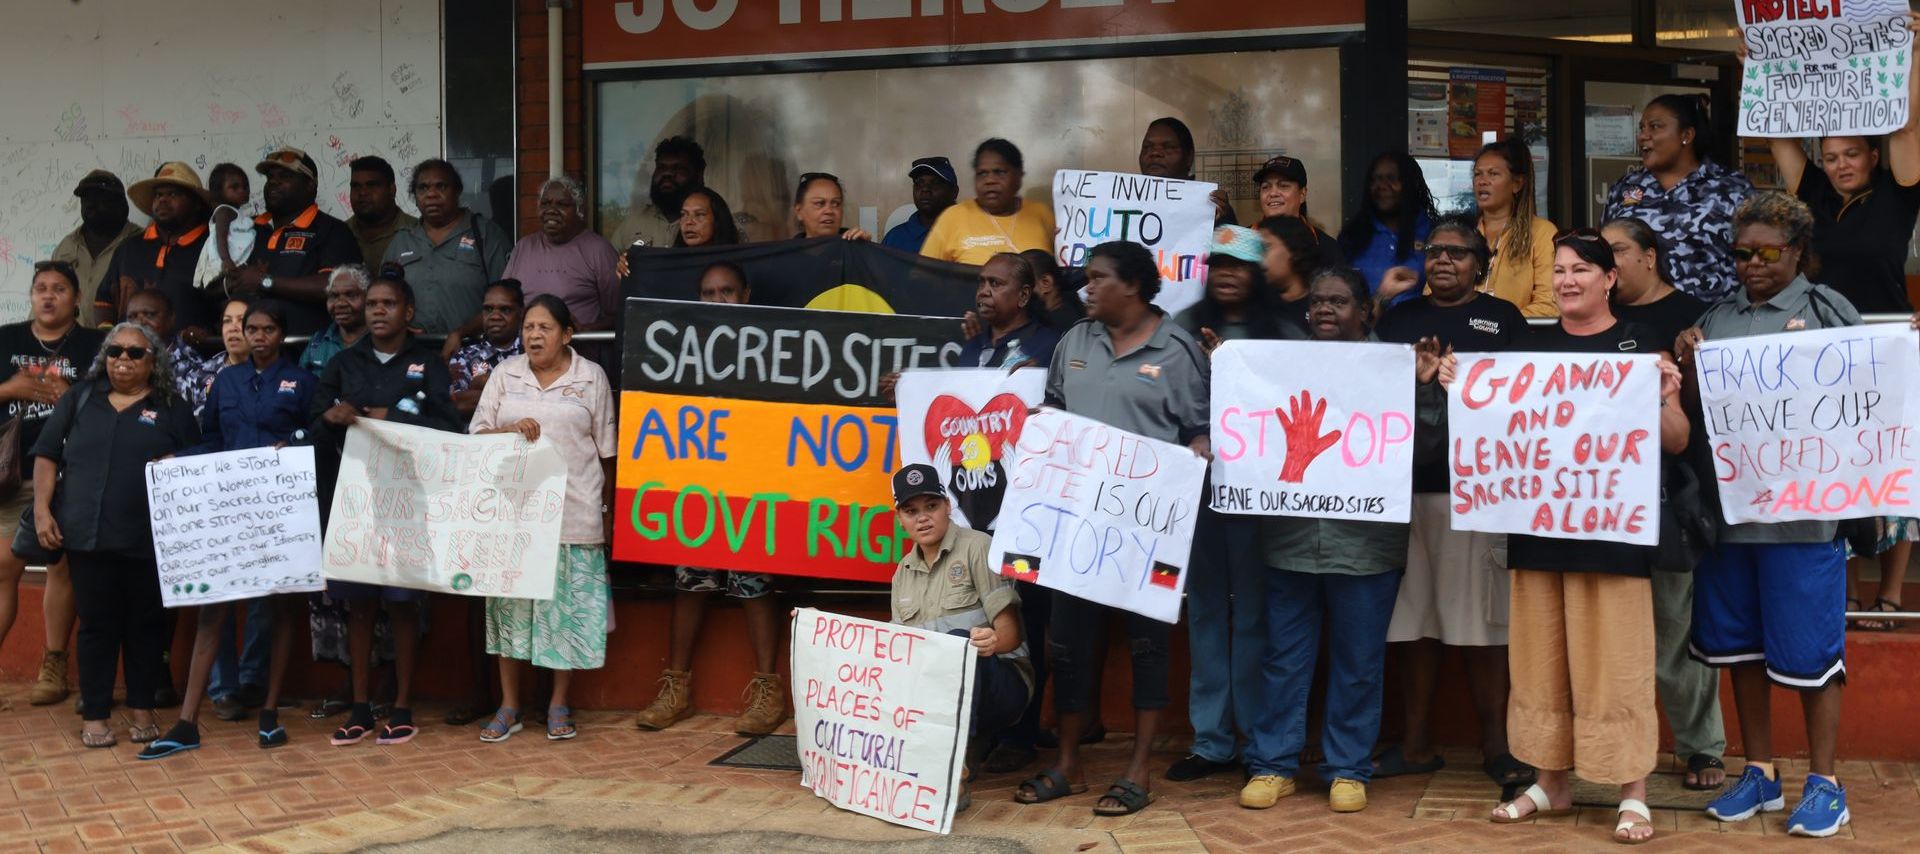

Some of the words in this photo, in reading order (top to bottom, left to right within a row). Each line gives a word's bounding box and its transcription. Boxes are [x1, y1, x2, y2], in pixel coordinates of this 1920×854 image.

[1745, 25, 1828, 61] SACRED
[1766, 68, 1873, 101] FUTURE
[1804, 64, 1819, 73] FOR
[1821, 62, 1838, 71] THE
[1746, 97, 1907, 136] GENERATION
[1061, 173, 1098, 199] WE
[1112, 175, 1185, 202] INVITE
[1157, 248, 1209, 287] WITH
[640, 320, 832, 391] SACRED
[1700, 344, 1799, 394] FRACK
[1813, 337, 1888, 387] OFF
[940, 406, 1014, 438] COUNTRY
[1507, 400, 1575, 437] AND
[1708, 398, 1798, 435] LEAVE
[1811, 390, 1884, 431] OUR
[632, 405, 730, 461] ARE
[787, 414, 898, 473] NOT
[1018, 411, 1159, 480] SACRED
[1454, 436, 1551, 477] LEAVE
[1574, 429, 1649, 465] OUR
[1715, 436, 1840, 482] SACRED
[1850, 424, 1915, 467] SITE
[366, 438, 536, 486] PROTECT
[956, 462, 997, 492] OURS
[152, 487, 176, 504] For
[182, 483, 214, 497] our
[176, 502, 201, 516] our
[266, 486, 317, 504] Ground
[341, 484, 415, 520] OUR
[425, 487, 564, 523] SACRED
[1013, 457, 1087, 501] SITE
[1094, 481, 1125, 517] IS
[1211, 485, 1253, 511] LEAVE
[1260, 490, 1291, 512] OUR
[1291, 492, 1344, 514] SACRED
[1345, 497, 1385, 514] SITES
[1454, 474, 1542, 515] SACRED
[1551, 466, 1621, 499] SITE
[1771, 468, 1913, 514] ALONE
[181, 518, 206, 533] one
[255, 505, 296, 520] voice
[631, 482, 791, 555] GOVT
[1531, 501, 1646, 534] ALONE
[447, 529, 532, 570] KEEP
[1015, 502, 1158, 590] STORY
[813, 616, 926, 665] PROTECT
[838, 663, 883, 692] OUR
[806, 679, 882, 721] PLACES
[893, 706, 925, 731] OF
[815, 719, 919, 778] CULTURAL
